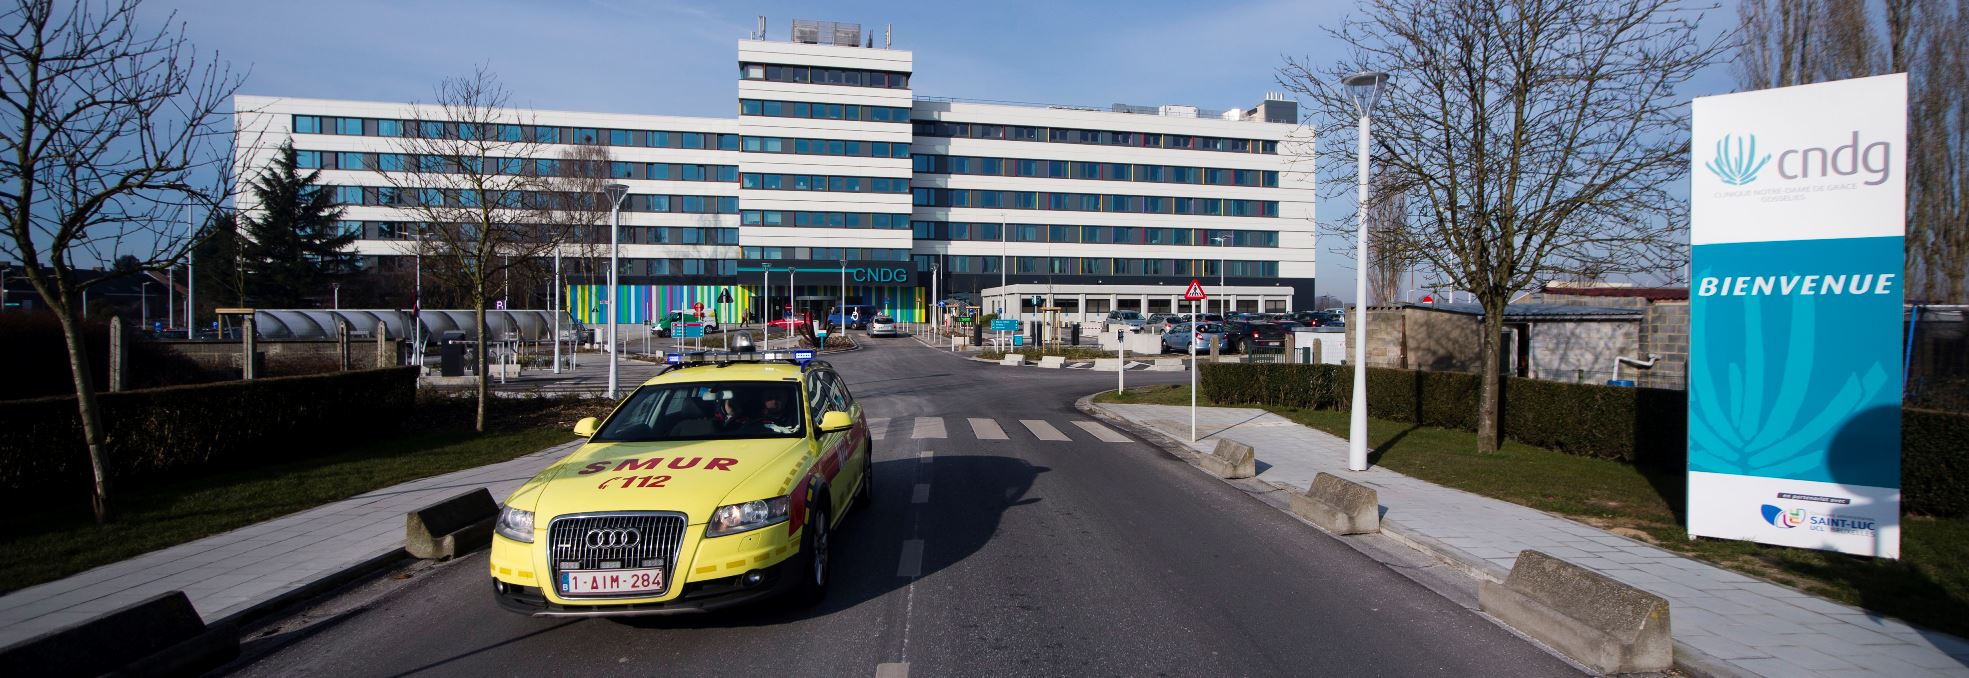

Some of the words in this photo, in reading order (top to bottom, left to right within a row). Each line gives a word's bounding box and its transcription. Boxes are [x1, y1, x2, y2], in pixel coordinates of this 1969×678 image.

[1778, 130, 1891, 186] cndg
[853, 267, 907, 282] CNDG
[1697, 273, 1896, 297] BIENVENUE
[578, 456, 739, 475] SMUR
[620, 475, 672, 489] 112
[1810, 516, 1875, 531] SAINT-LUC
[572, 572, 661, 590] 1-AIM-284
